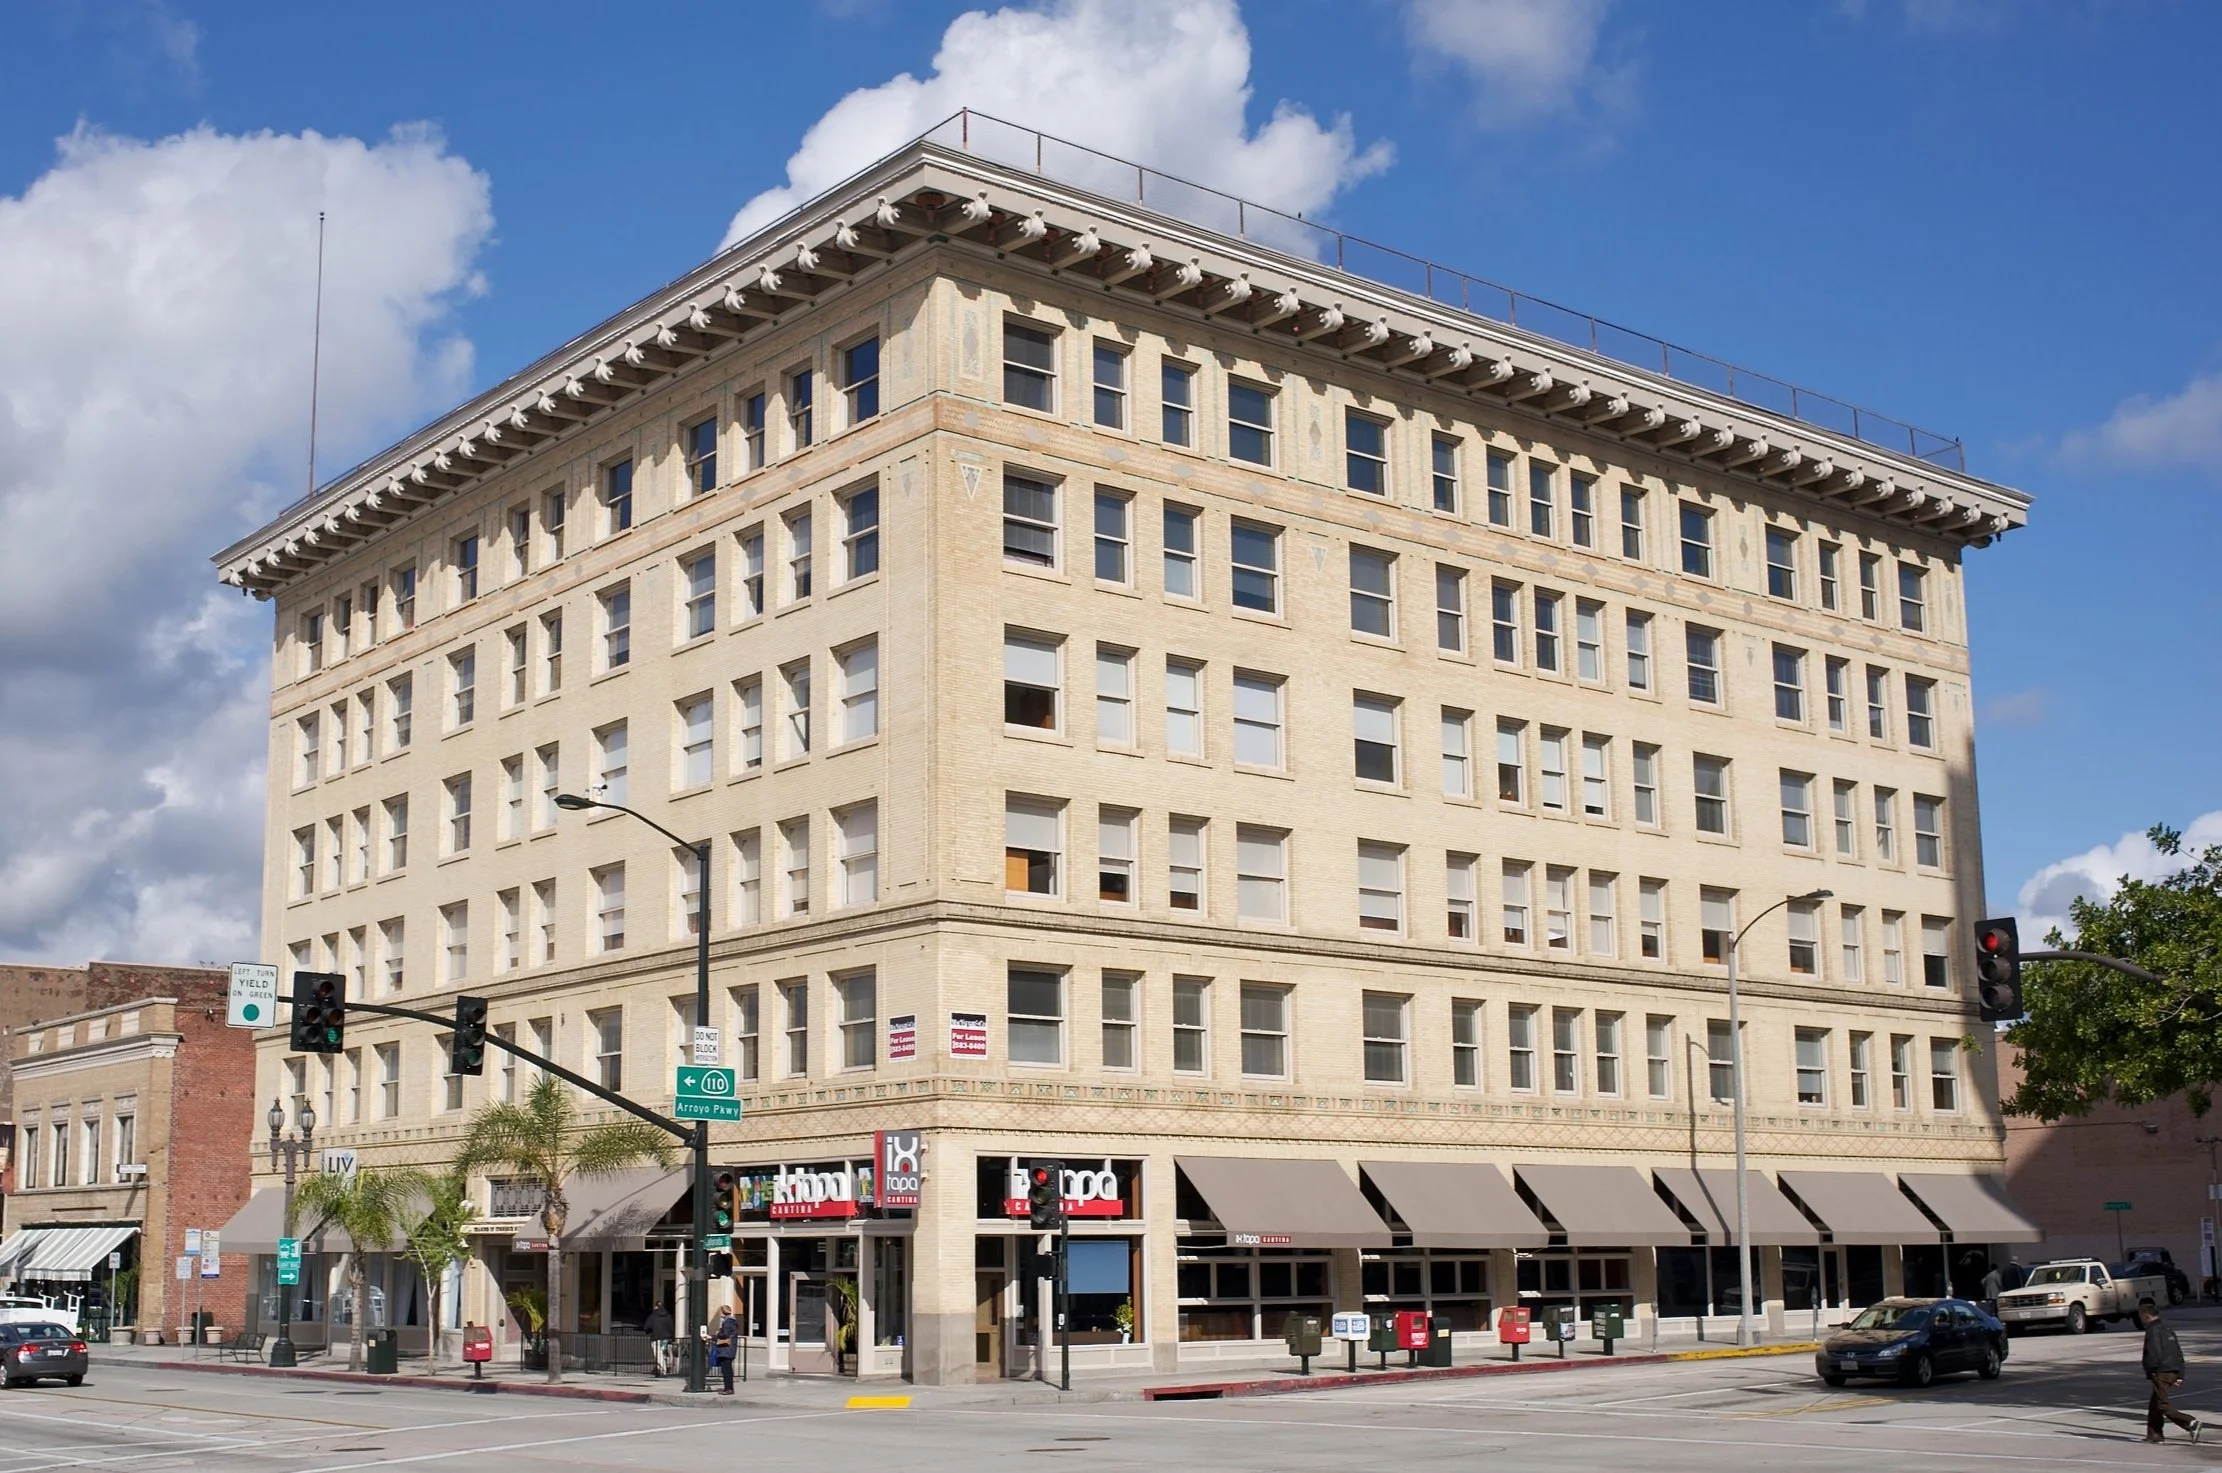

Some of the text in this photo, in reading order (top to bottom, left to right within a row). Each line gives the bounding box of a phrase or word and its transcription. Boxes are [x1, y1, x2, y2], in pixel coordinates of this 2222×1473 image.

[239, 979, 269, 988] YIELD
[249, 991, 273, 999] GREEN
[696, 1032, 718, 1041] DO NOT
[696, 1044, 717, 1053] BLOCK
[706, 1078, 725, 1090] 110
[677, 1103, 739, 1117] Arroyo Pkwy
[329, 1157, 354, 1173] LIV
[887, 1174, 918, 1193] tapa
[887, 1196, 918, 1204] CANTINA
[772, 1205, 812, 1214] CANTINA
